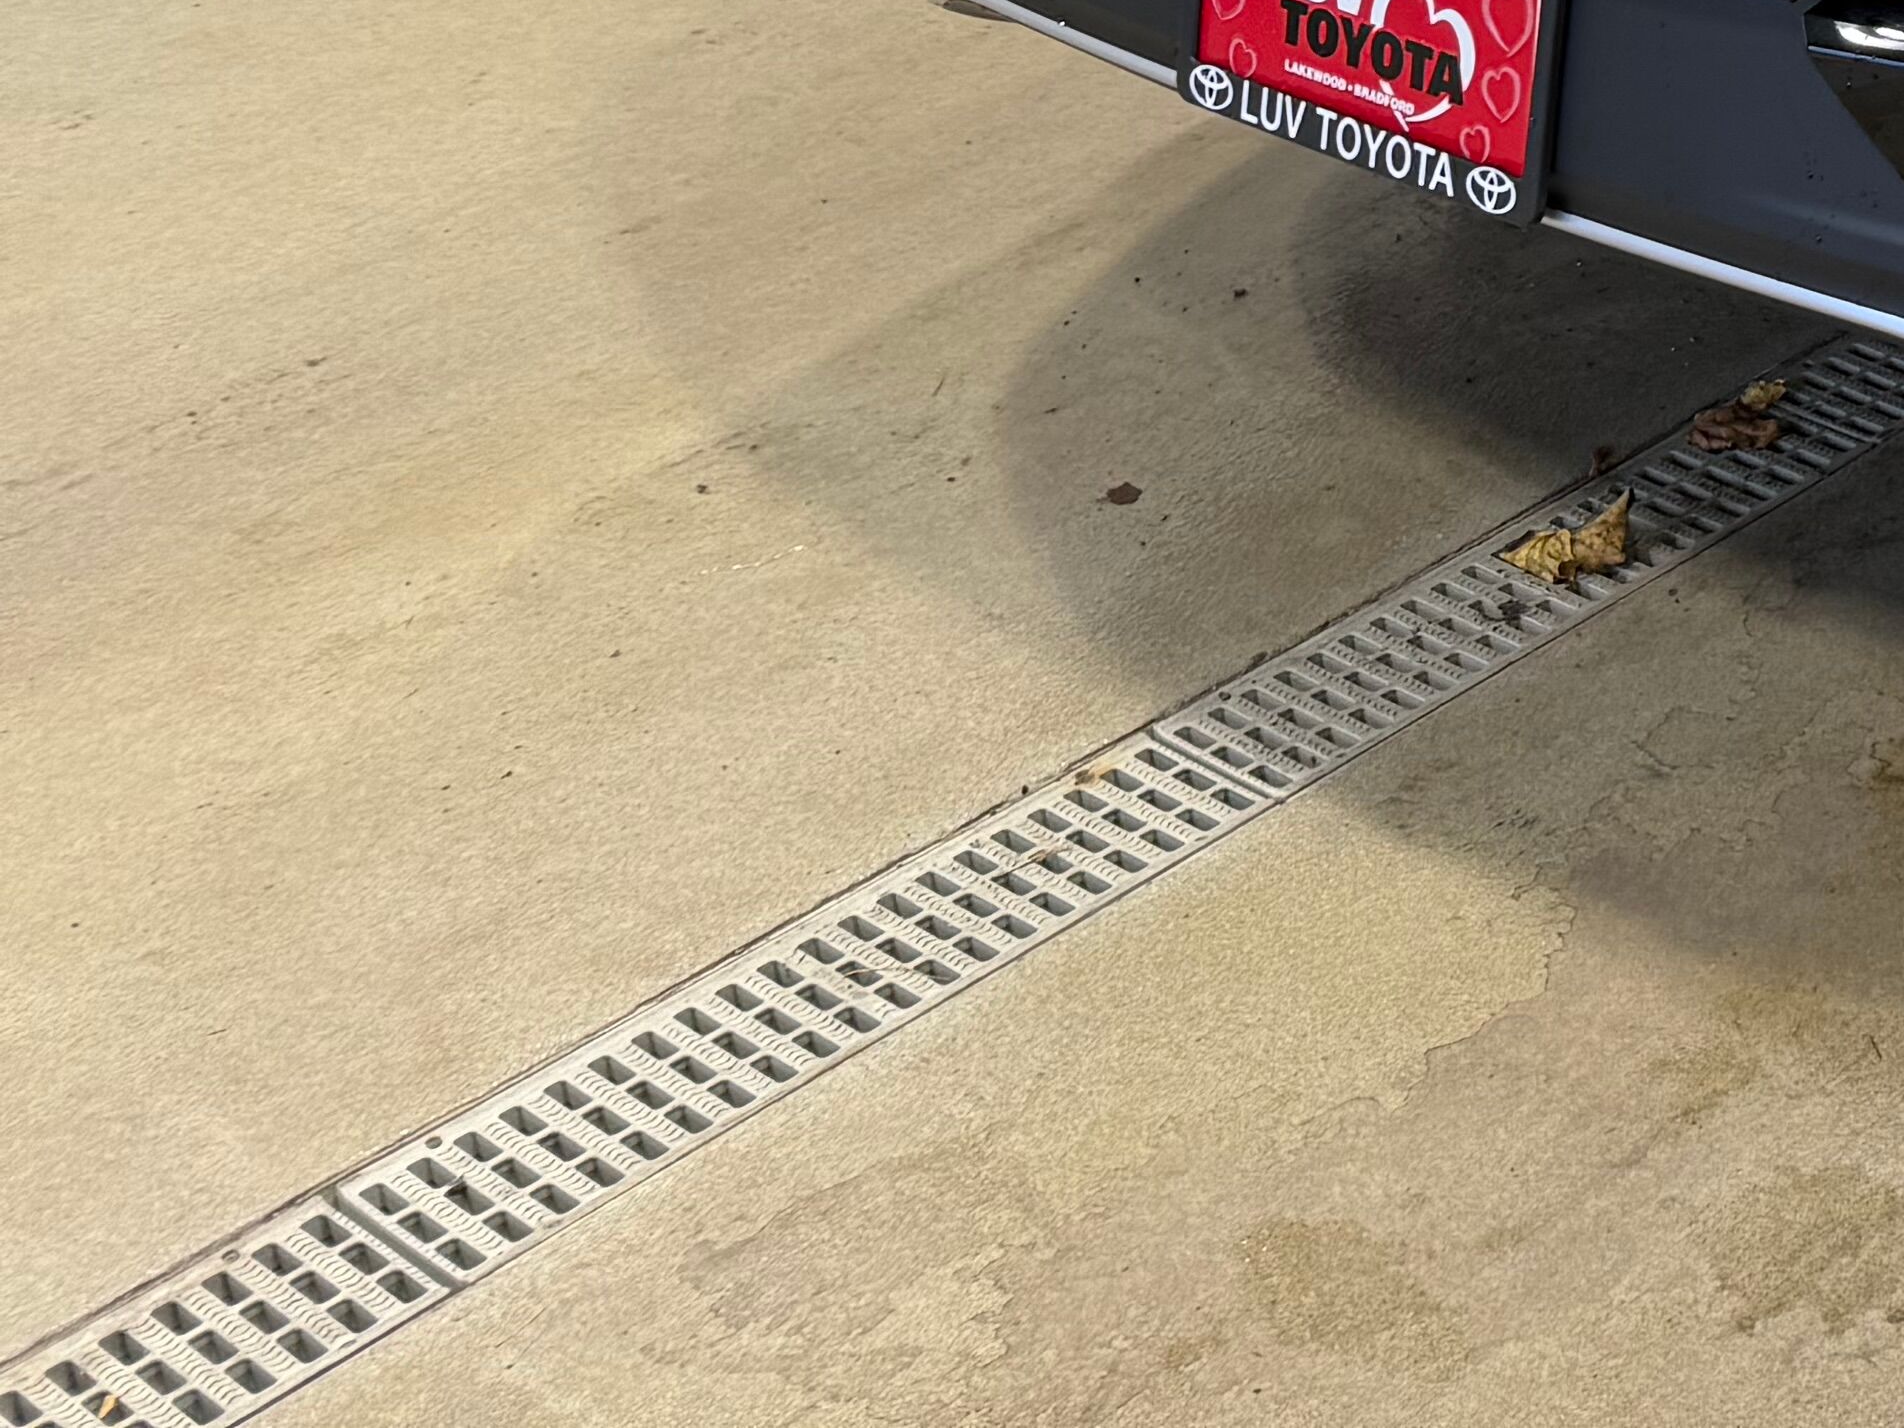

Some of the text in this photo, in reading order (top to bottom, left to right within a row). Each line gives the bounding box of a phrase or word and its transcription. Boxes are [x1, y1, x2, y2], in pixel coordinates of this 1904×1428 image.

[1284, 59, 1415, 117] LAKEWOOD BRADFORD
[1240, 79, 1455, 199] LUV TOYOTA
